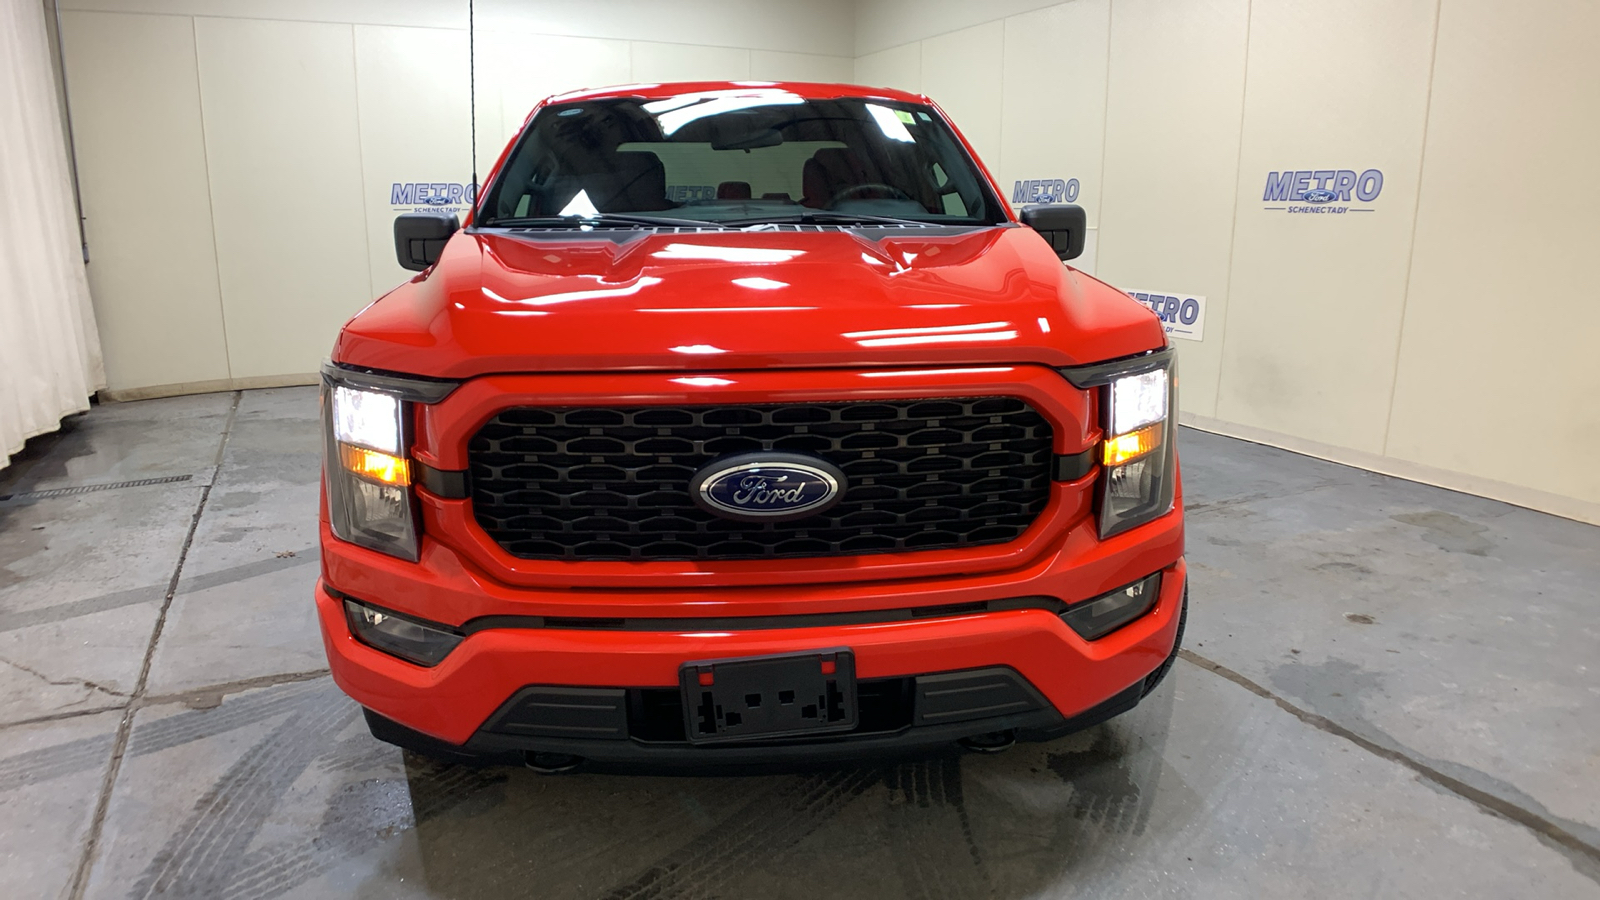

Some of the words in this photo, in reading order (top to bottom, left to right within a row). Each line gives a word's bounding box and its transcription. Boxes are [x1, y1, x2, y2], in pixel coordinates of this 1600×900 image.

[391, 183, 481, 205] METRO
[1012, 178, 1080, 203] METRO
[1263, 169, 1384, 202] METRO
[1308, 191, 1330, 202] Ford
[1287, 206, 1349, 214] SCHENECTADY
[1127, 292, 1199, 325] TRO
[733, 475, 806, 504] Ford
